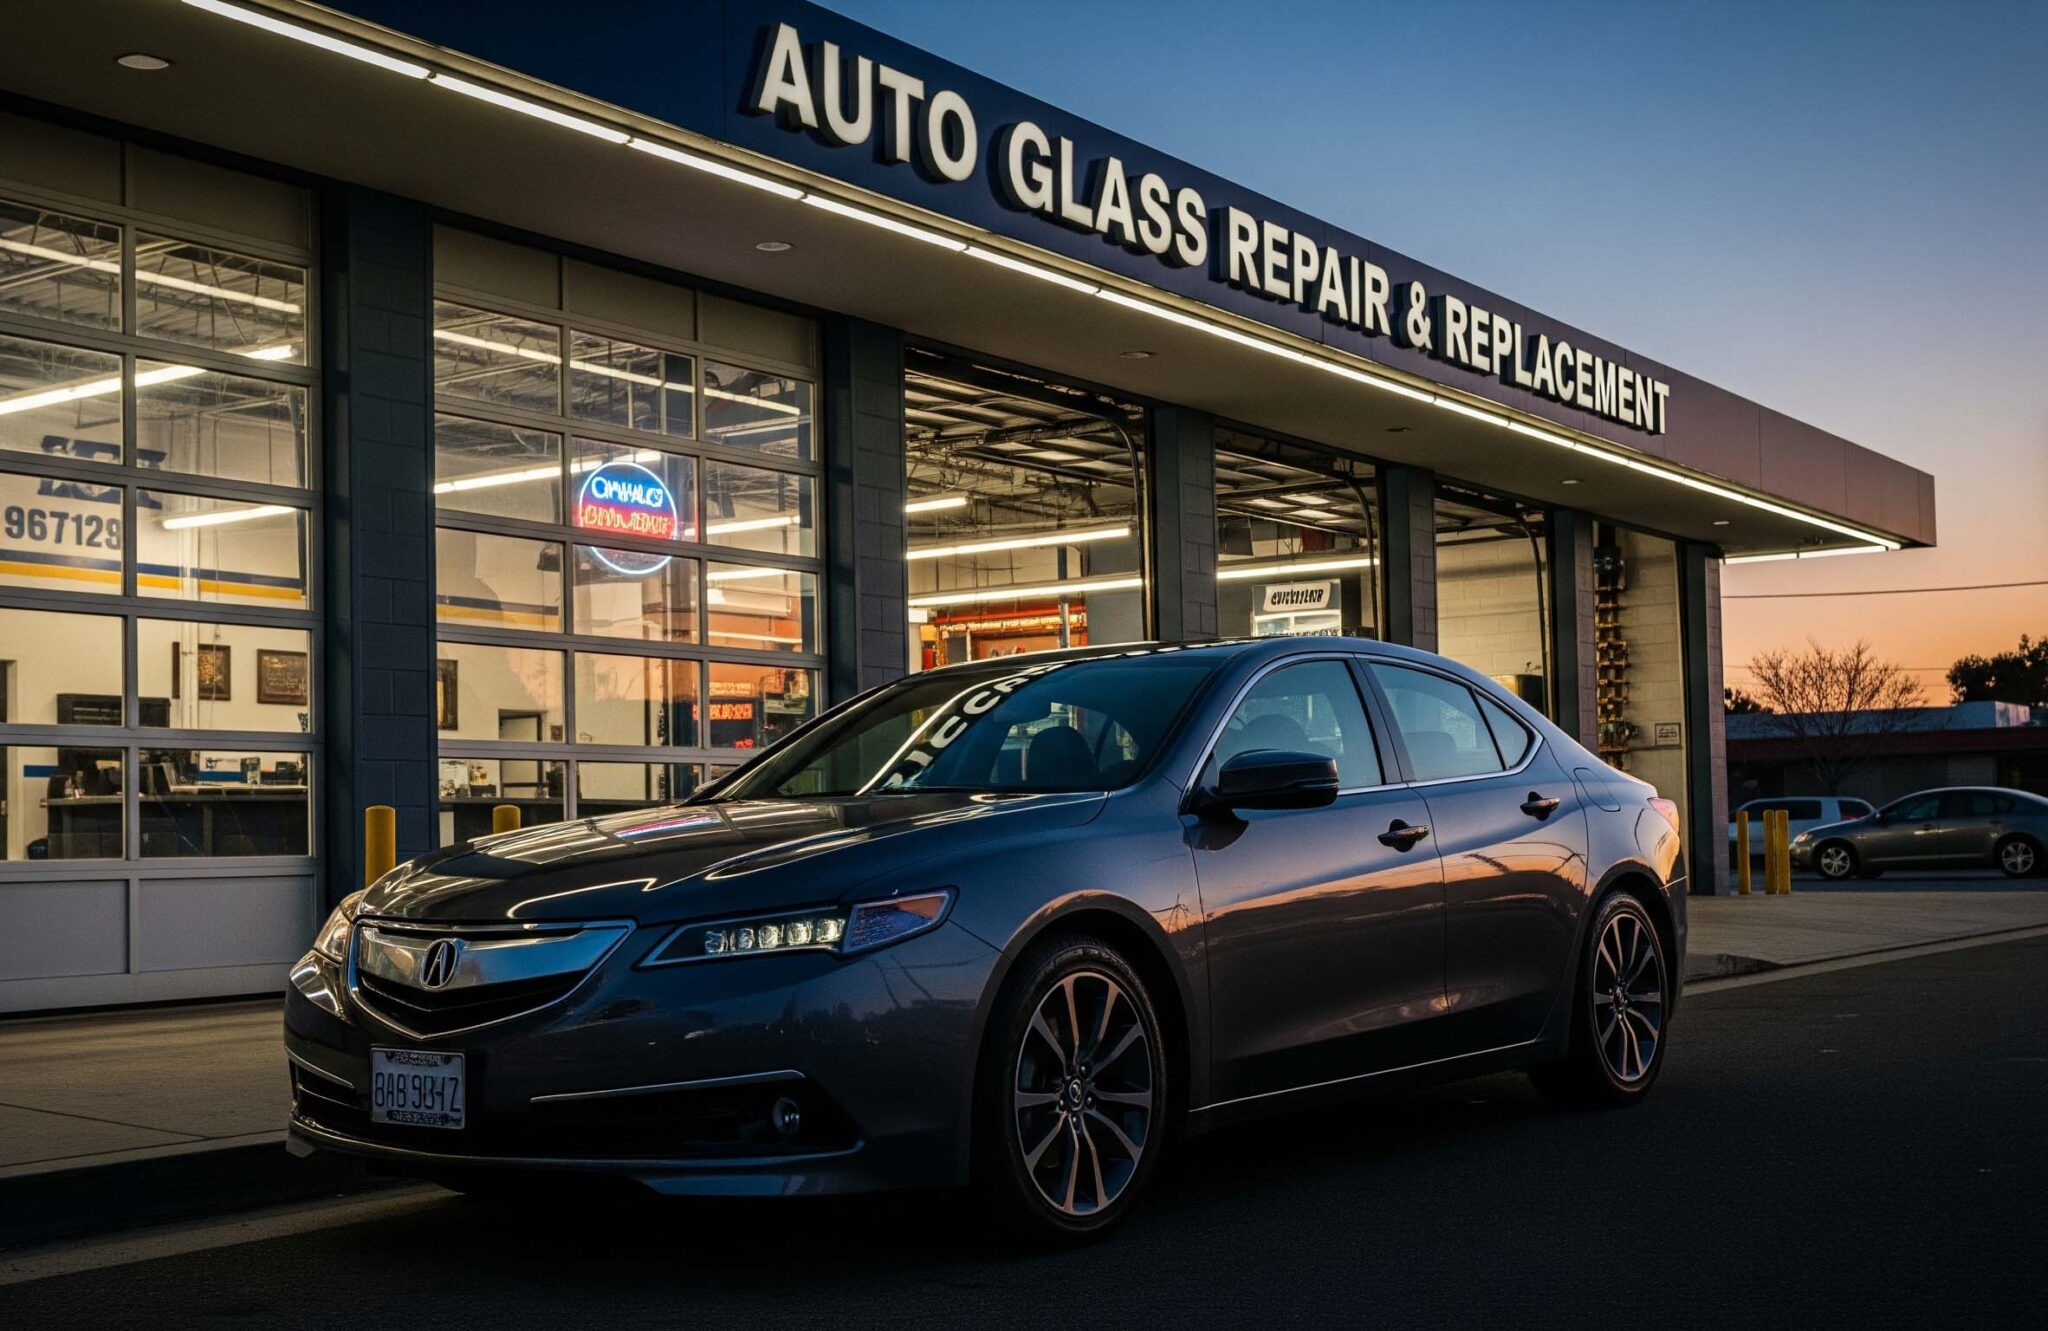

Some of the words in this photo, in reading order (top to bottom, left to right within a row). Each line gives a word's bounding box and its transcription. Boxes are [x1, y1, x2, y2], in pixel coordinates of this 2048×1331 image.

[757, 21, 978, 182] AUTO
[1007, 120, 1208, 267] GLASS
[1227, 205, 1391, 337] REPAIR
[1406, 280, 1432, 350] &
[1445, 293, 1670, 435] REPLACEMENT
